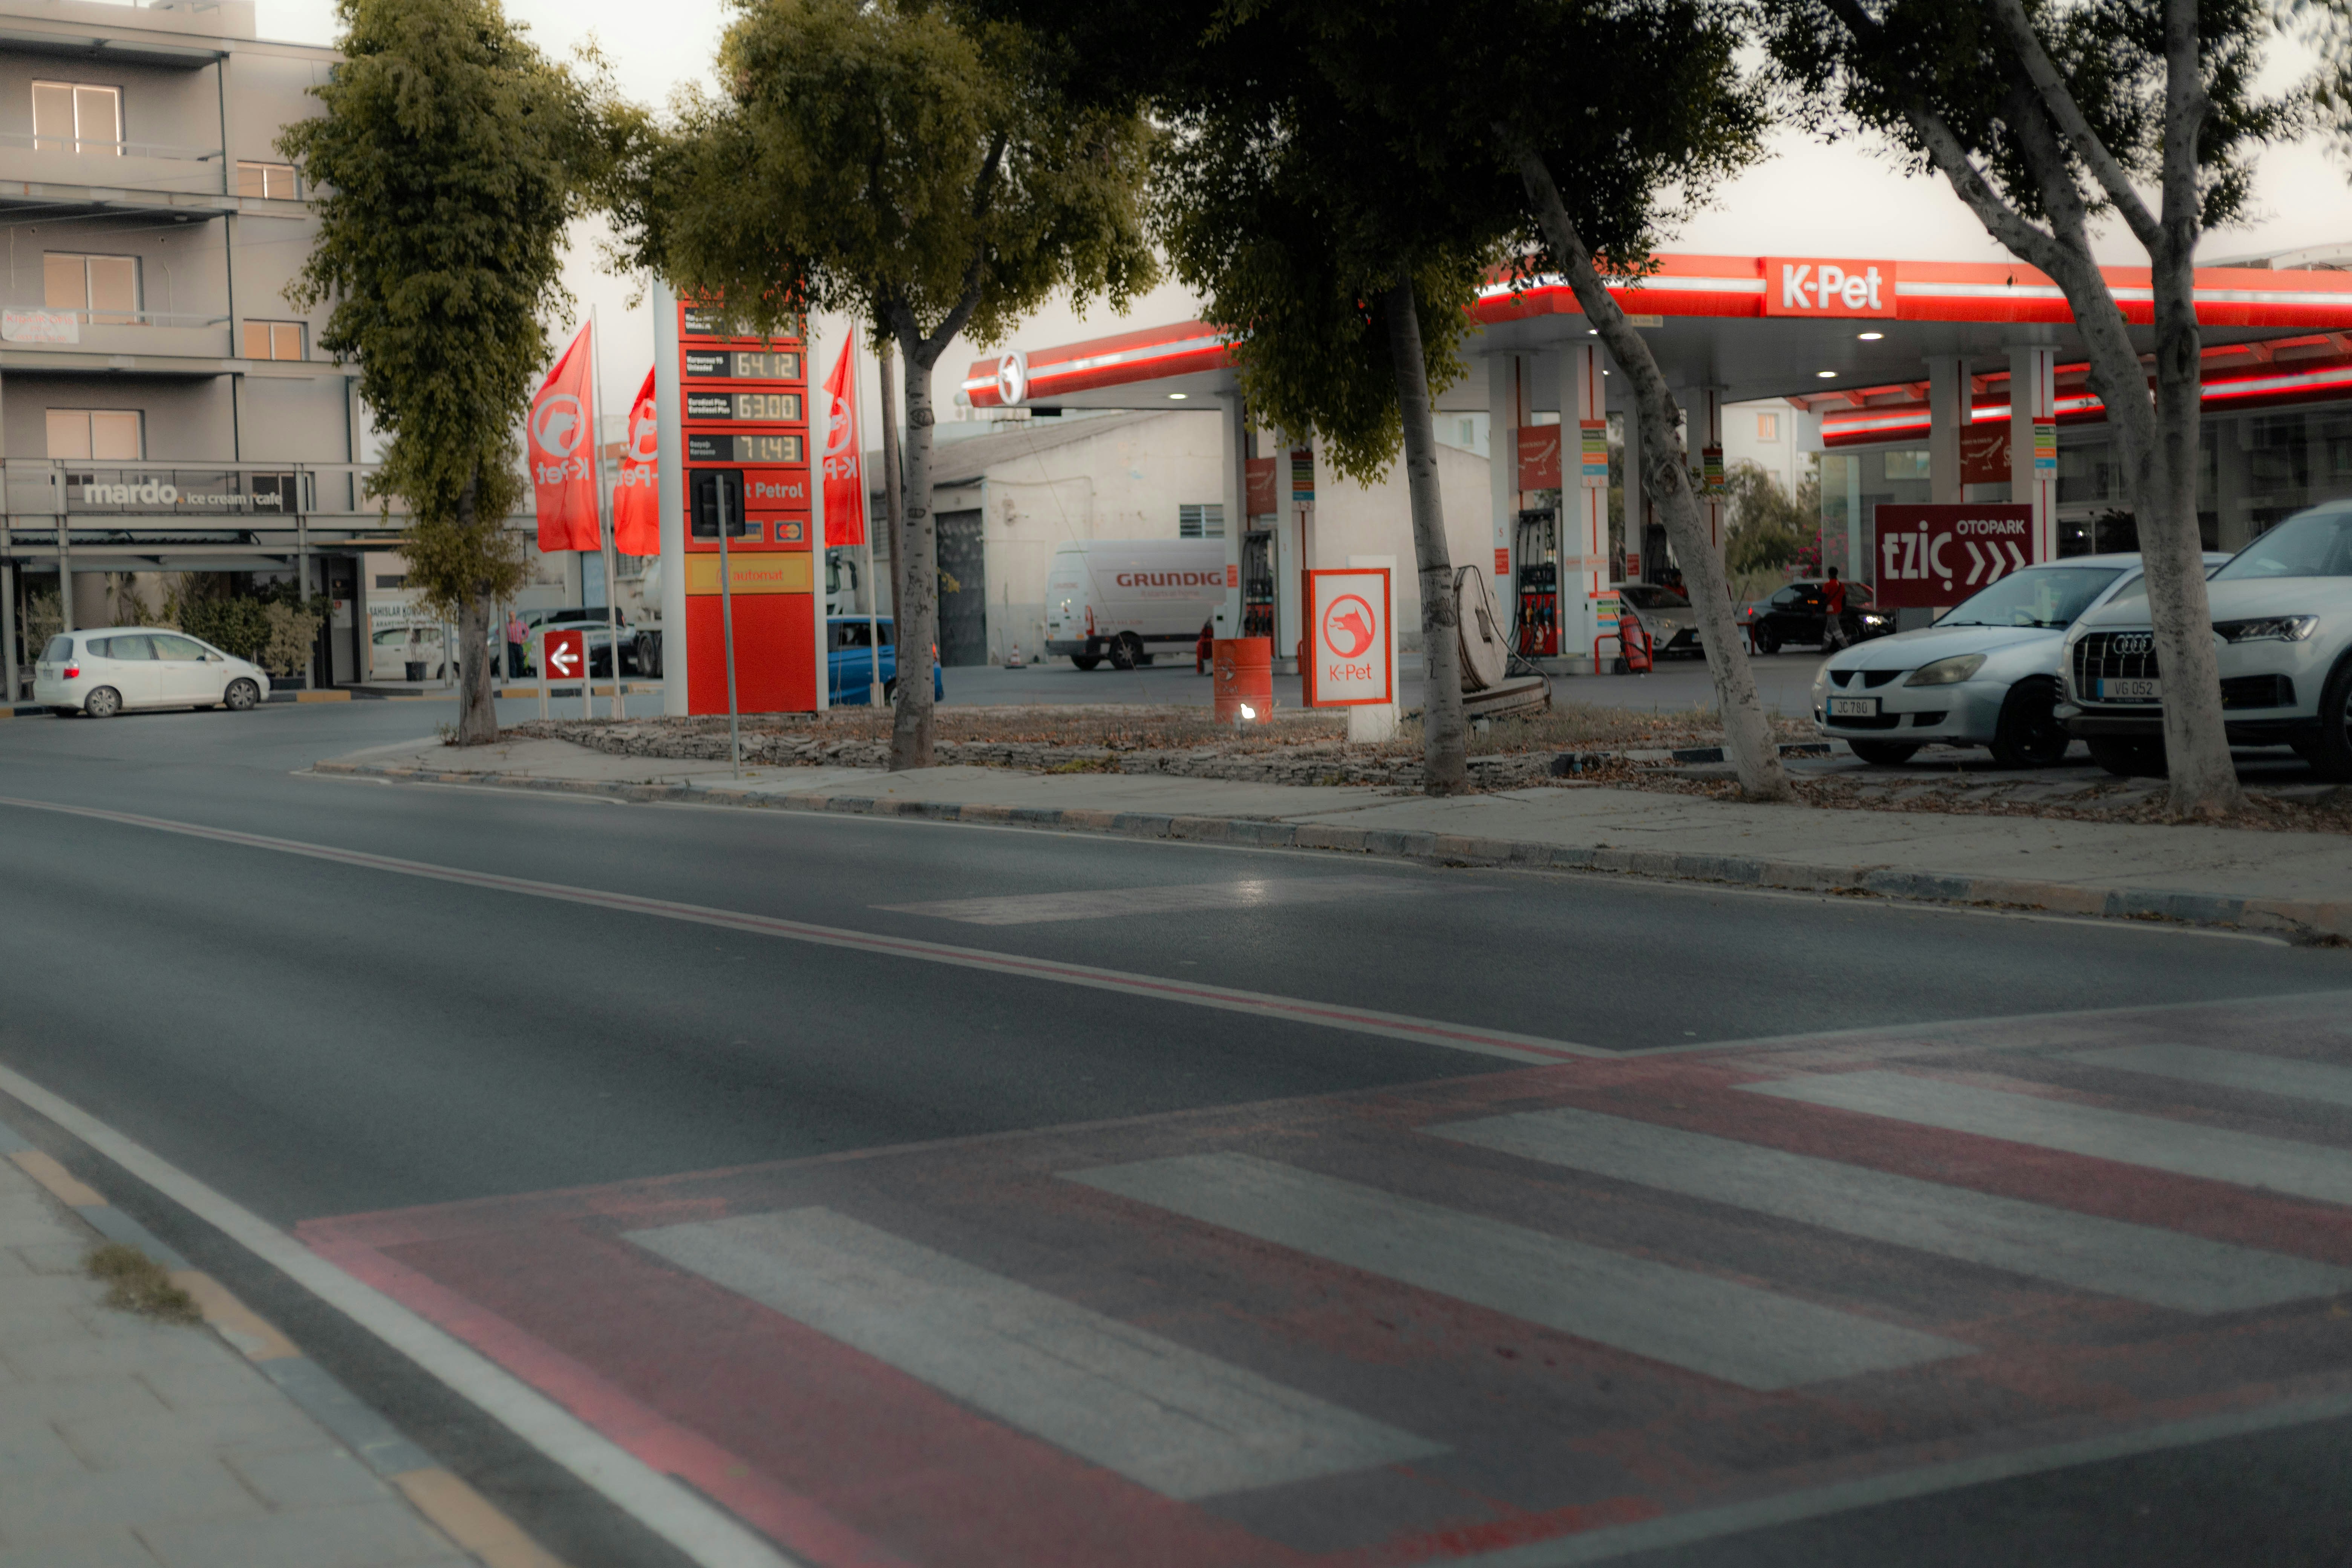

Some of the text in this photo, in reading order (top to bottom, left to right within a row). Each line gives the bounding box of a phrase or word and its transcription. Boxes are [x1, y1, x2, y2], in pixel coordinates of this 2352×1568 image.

[1782, 264, 1882, 310] K-Pet
[738, 352, 793, 376] 64.12
[739, 394, 794, 418] 63.00
[741, 435, 795, 460] 71.43
[83, 478, 178, 504] mardo
[207, 494, 247, 505] cream
[755, 482, 804, 498] Petrol
[1882, 520, 2025, 591] EZİÇ OTOPARK
[733, 570, 783, 581] automat
[1116, 572, 1222, 586] GRUNDIG
[1329, 663, 1372, 681] K-Pet
[2115, 682, 2153, 695] VG 052
[1838, 702, 1867, 714] JC 780
